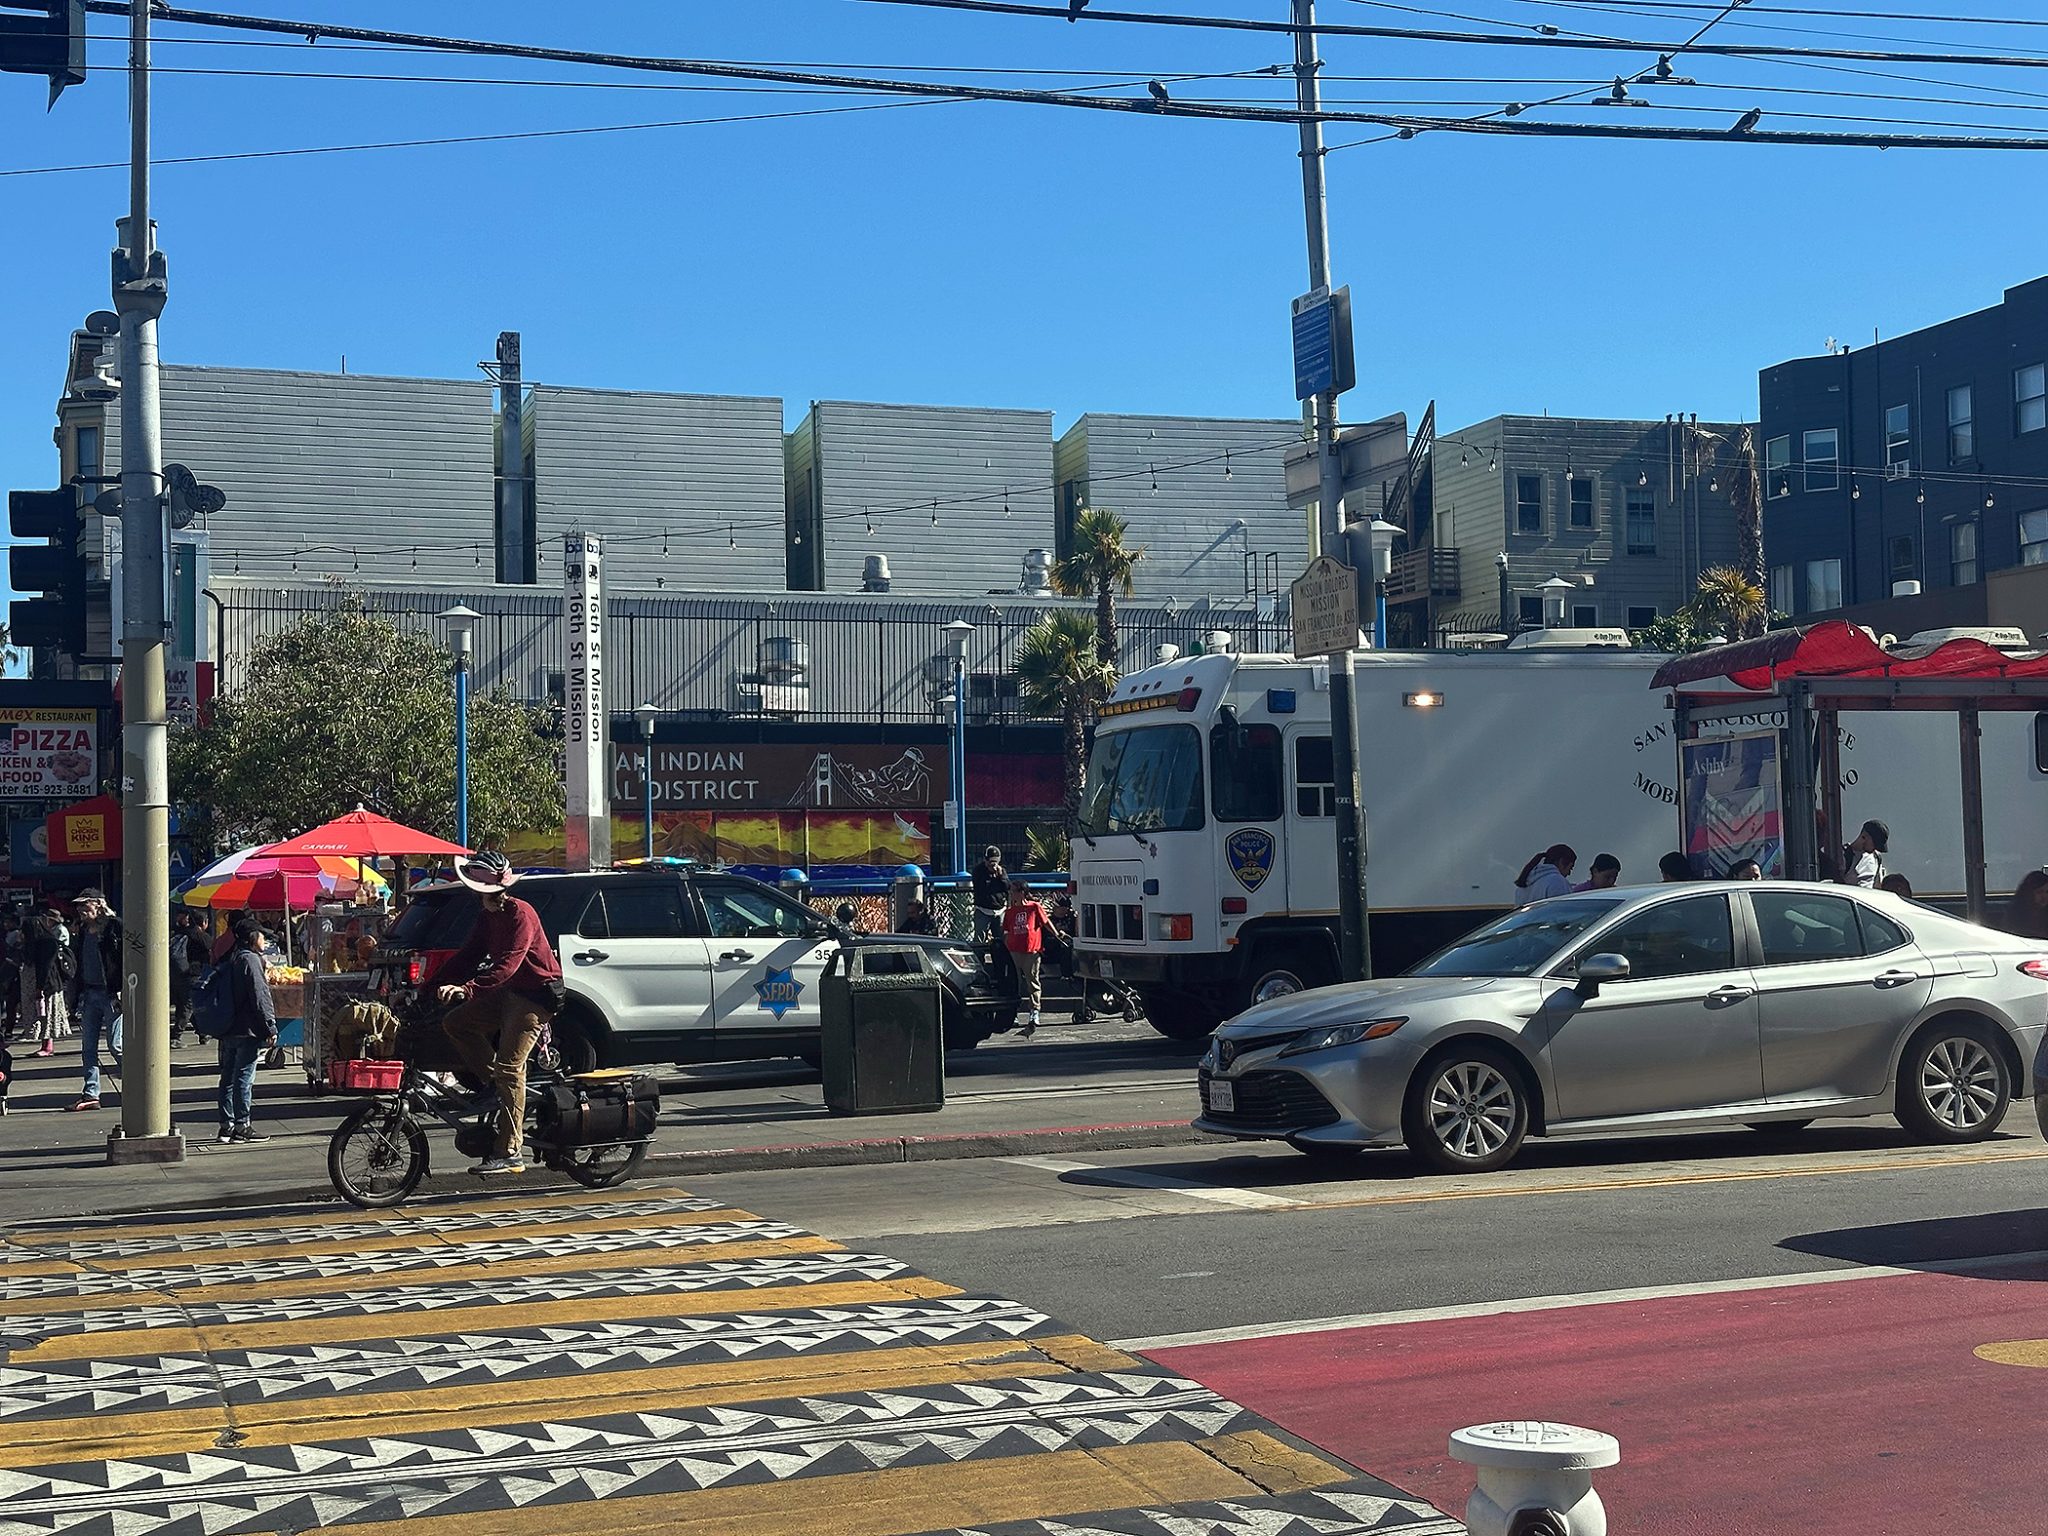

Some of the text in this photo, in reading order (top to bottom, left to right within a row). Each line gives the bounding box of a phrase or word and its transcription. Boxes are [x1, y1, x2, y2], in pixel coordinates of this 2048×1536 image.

[1310, 593, 1340, 613] MISSION
[1295, 618, 1306, 635] SAN
[1307, 612, 1336, 633] FRANCISCO
[570, 592, 585, 742] 16th St Mission
[590, 593, 602, 742] 16th St Mission
[35, 712, 92, 721] RESTAURANT
[13, 729, 92, 751] PIZZA
[1633, 722, 1668, 753] SAN
[0, 757, 47, 769] KEN &
[660, 751, 745, 771] INDIAN
[1693, 756, 1725, 777] Ashby
[22, 784, 92, 795] 415-923-8481
[650, 780, 760, 800] DISTRICT
[71, 833, 99, 842] KING
[1123, 875, 1138, 886] TWO
